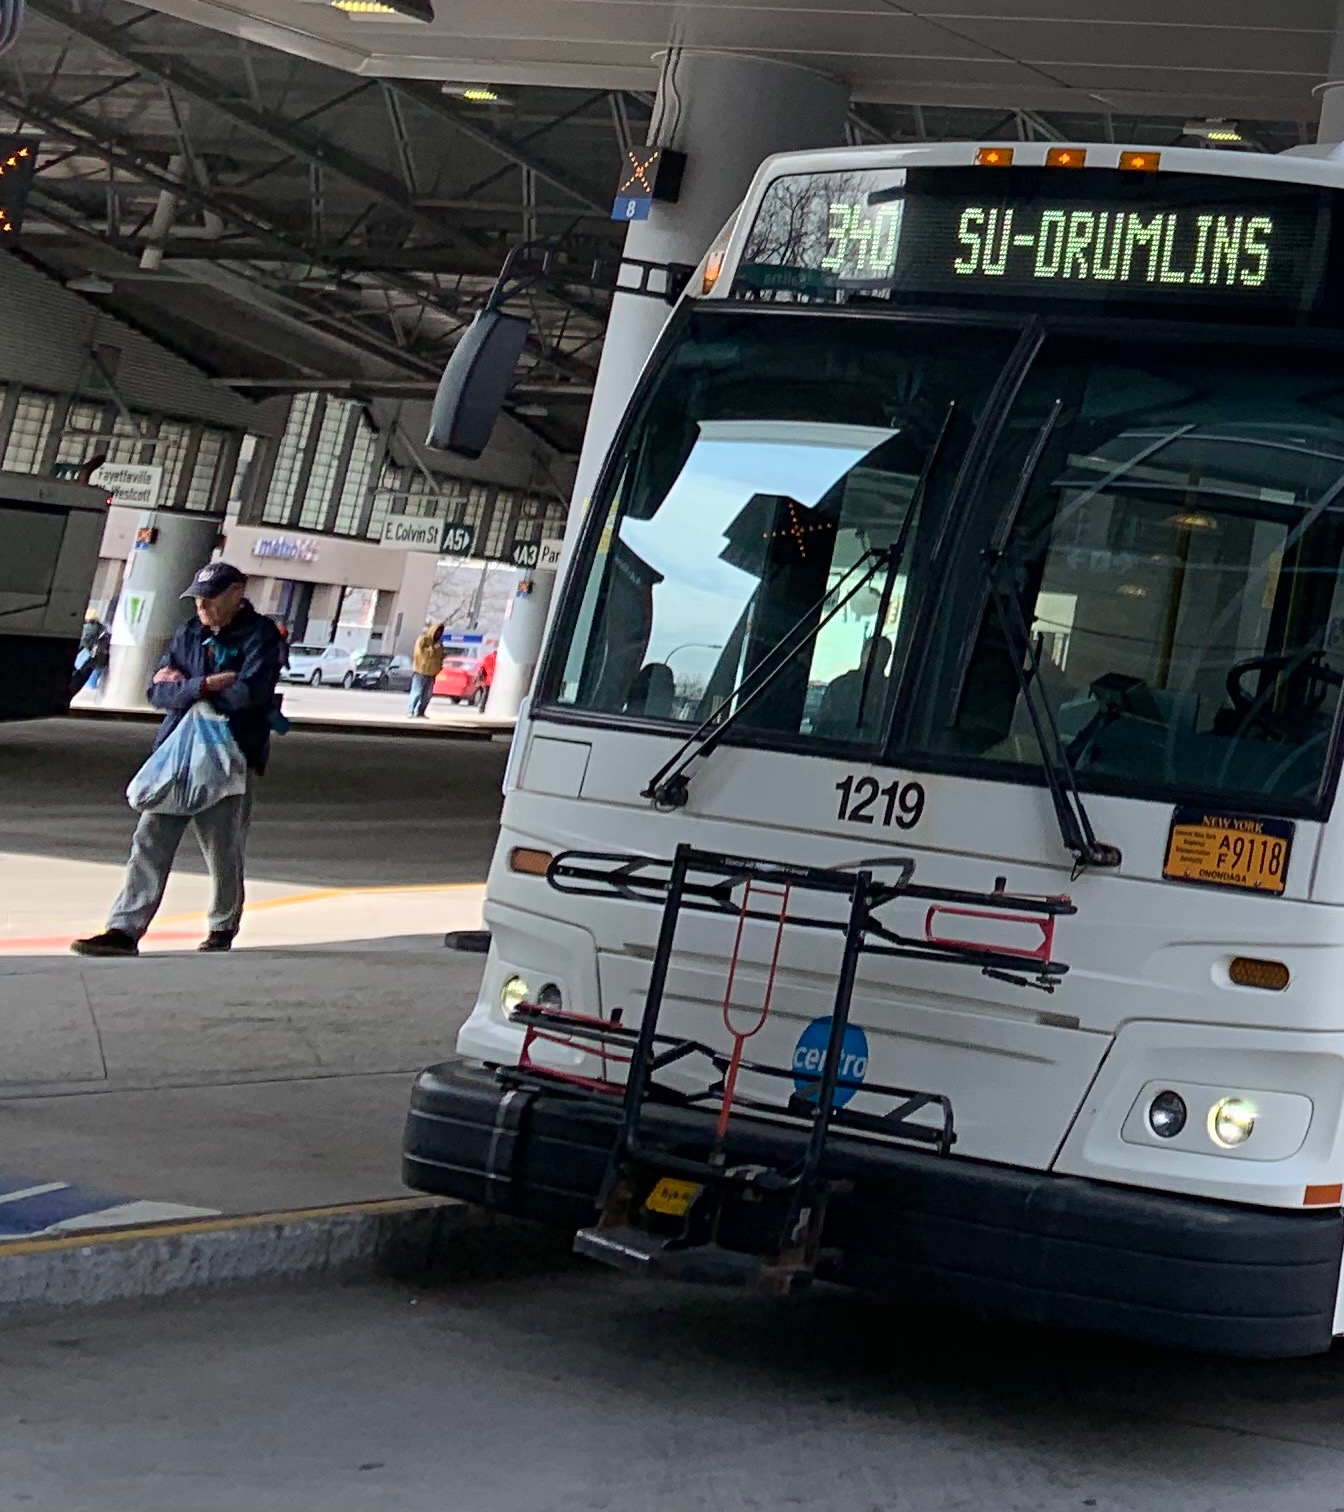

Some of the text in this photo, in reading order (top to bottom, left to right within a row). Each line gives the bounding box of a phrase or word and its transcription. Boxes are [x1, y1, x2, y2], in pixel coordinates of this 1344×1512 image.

[625, 199, 637, 218] 8
[820, 203, 899, 271] 340
[953, 207, 1275, 286] SU-DRUMLINS
[385, 523, 439, 544] E Colvin St
[443, 529, 464, 550] A5
[518, 544, 538, 566] A3
[835, 774, 926, 830] 1219
[1202, 815, 1264, 834] NEW YORK
[1231, 836, 1283, 876] 9118
[1199, 868, 1248, 884] ONONDAGA
